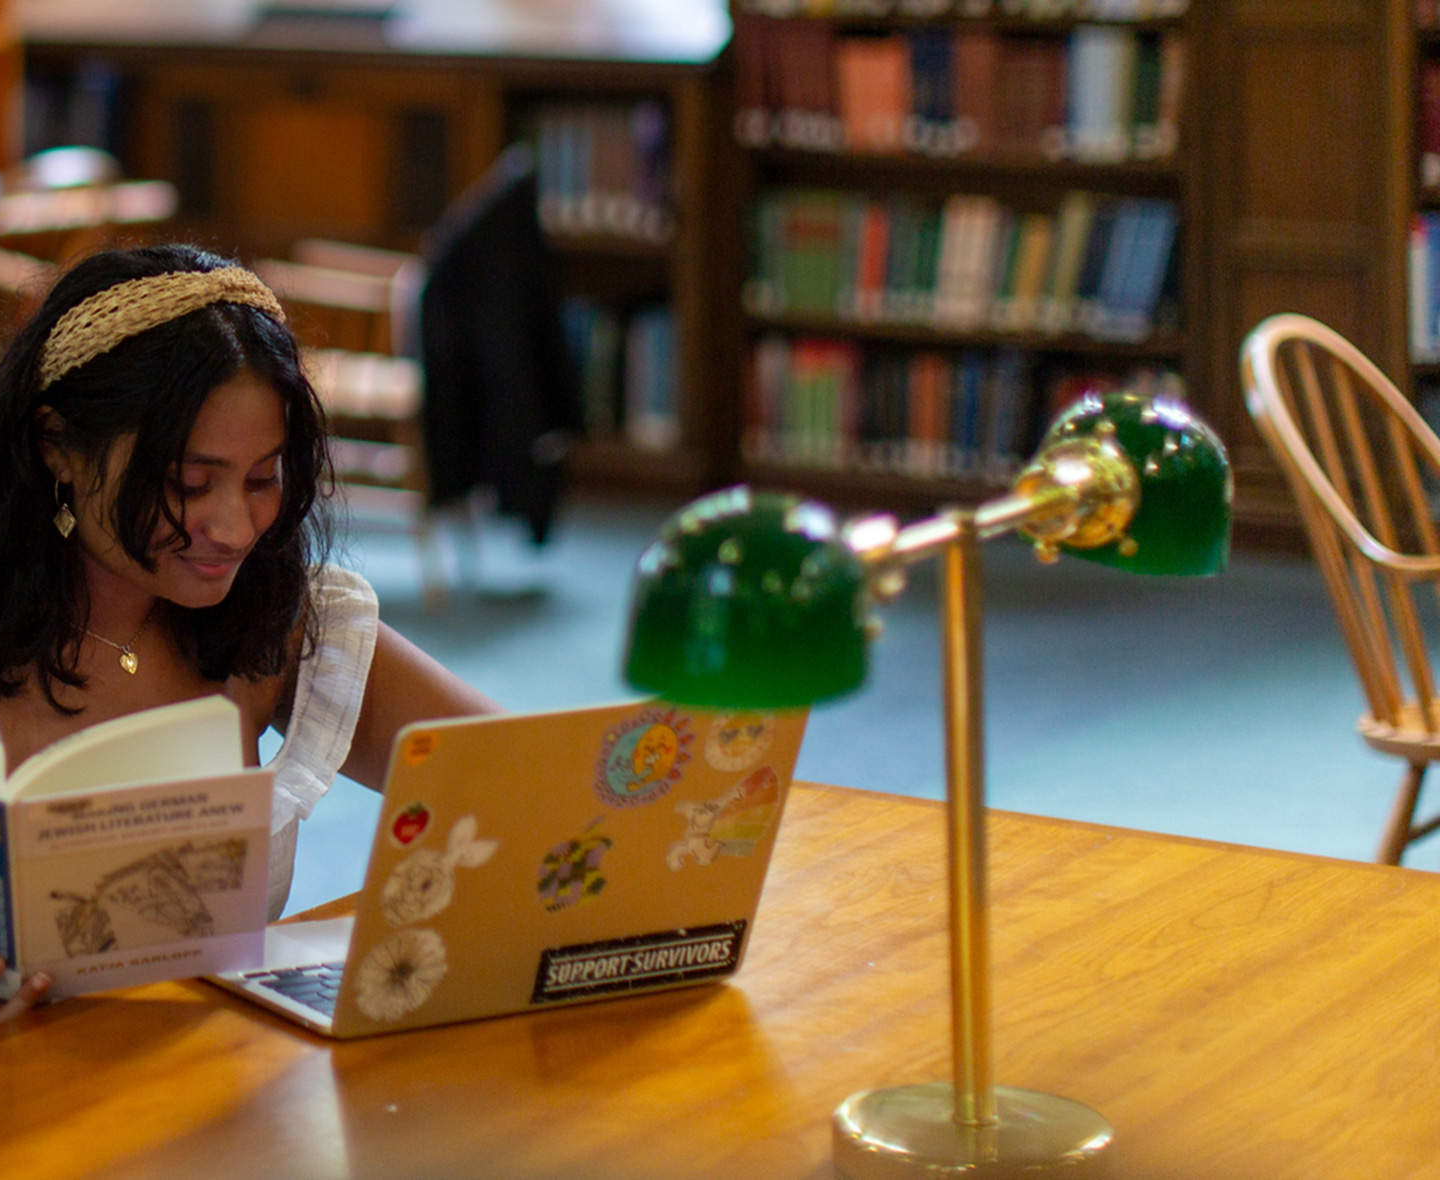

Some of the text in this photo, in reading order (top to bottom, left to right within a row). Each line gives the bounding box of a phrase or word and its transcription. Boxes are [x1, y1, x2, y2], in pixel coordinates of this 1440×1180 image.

[140, 792, 209, 811] GERMAN
[38, 821, 96, 842] JEWISH
[99, 809, 193, 832] LITERATURE
[199, 802, 245, 820] ANEW
[76, 960, 125, 976] KATJA
[546, 939, 732, 986] SUPPORT SURVIVORS
